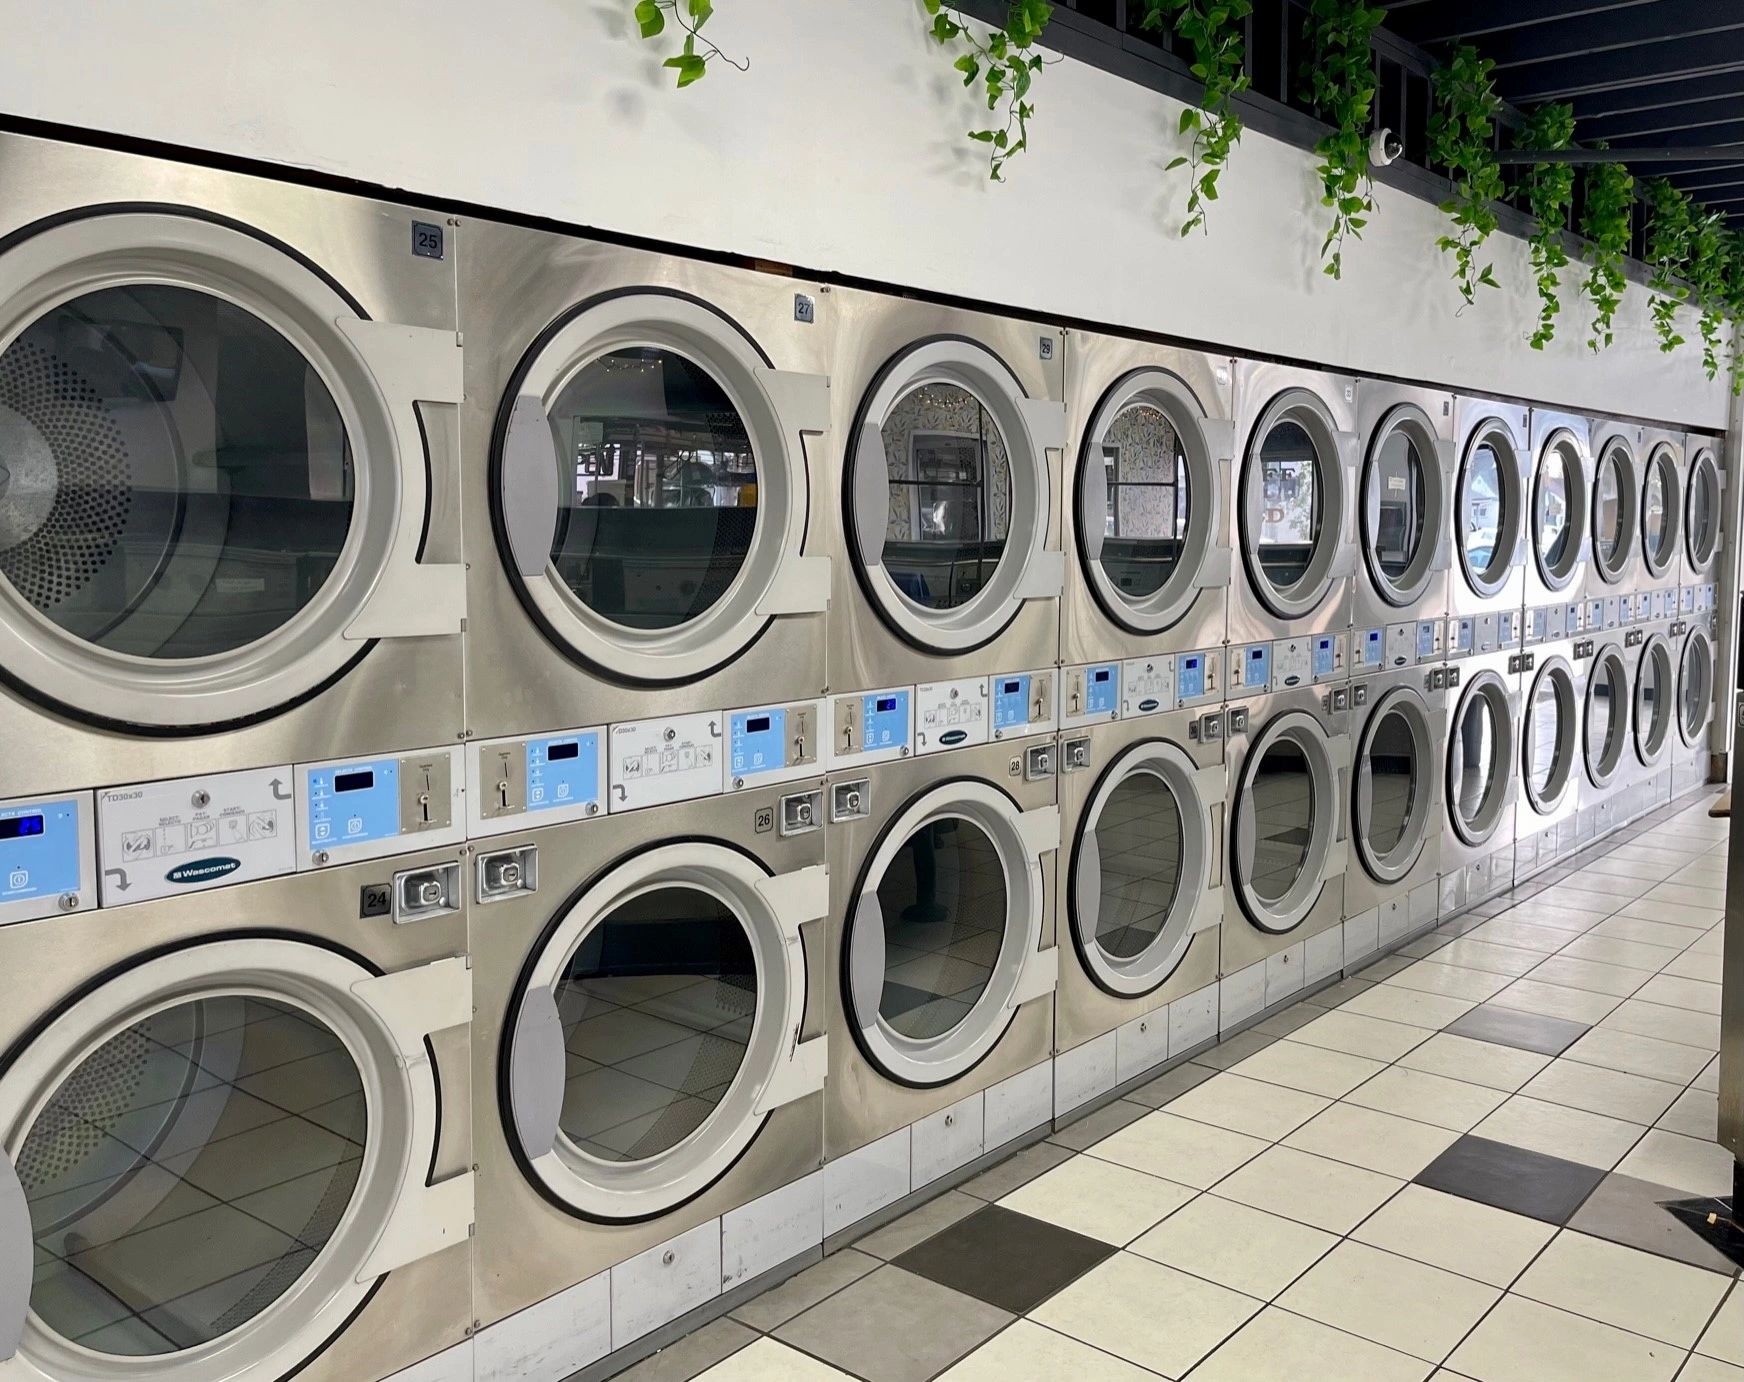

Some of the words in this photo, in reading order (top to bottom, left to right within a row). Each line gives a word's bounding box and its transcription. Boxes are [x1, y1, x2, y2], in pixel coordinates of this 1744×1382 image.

[418, 231, 438, 249] 25
[797, 301, 811, 315] 27
[1041, 343, 1051, 354] 29
[1010, 760, 1020, 771] 28
[107, 791, 143, 802] TD30x30
[757, 813, 771, 827] 26
[182, 862, 236, 878] Wascomat
[366, 891, 387, 908] 24
